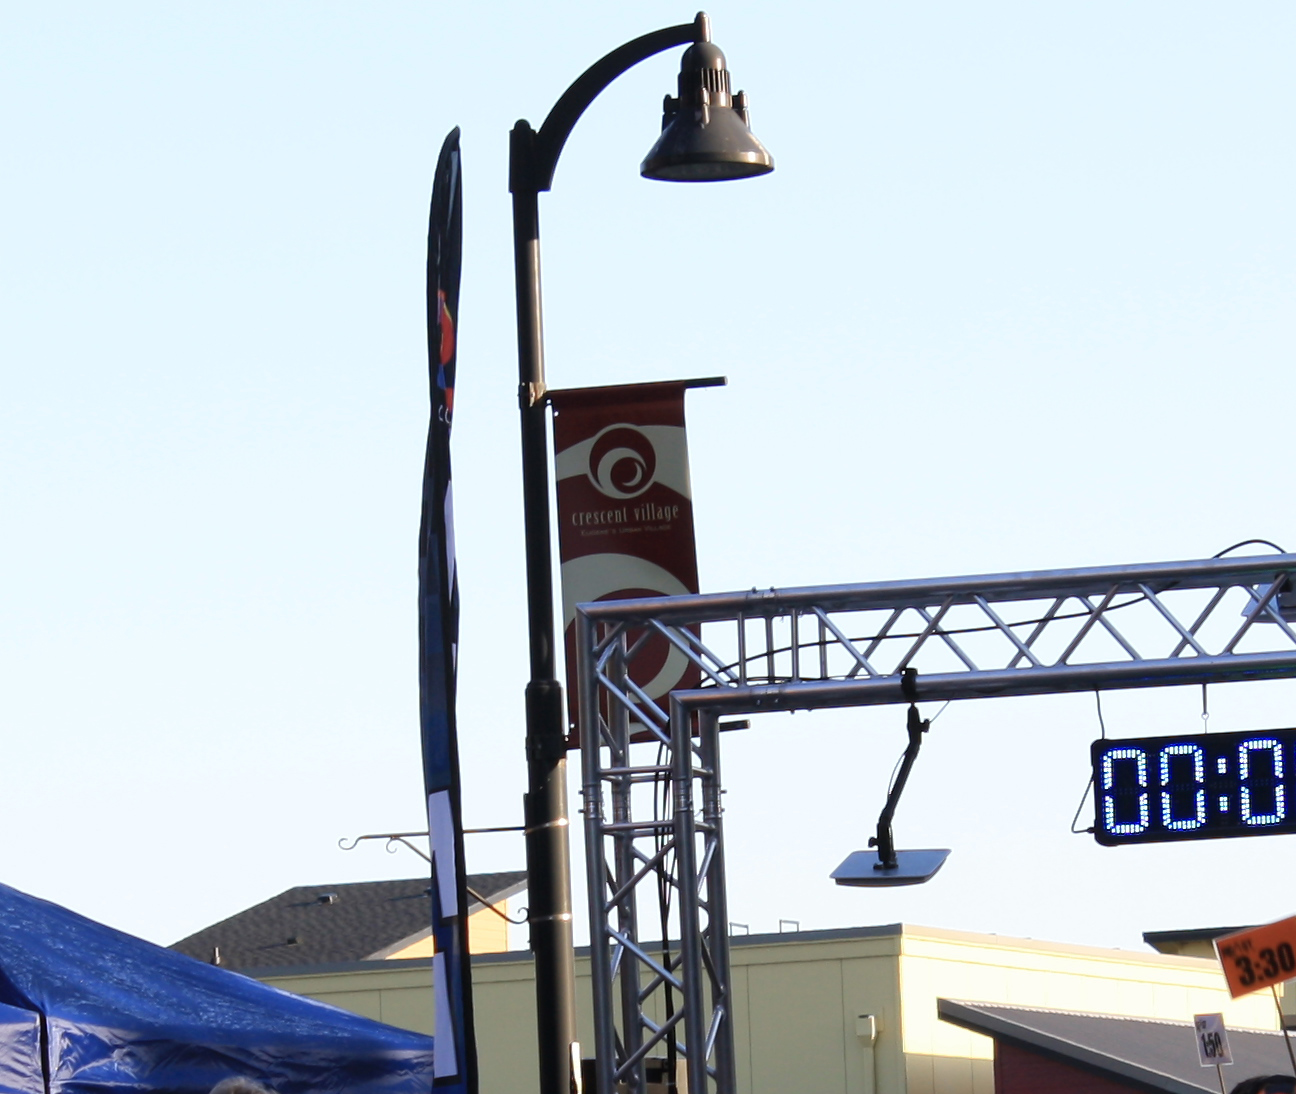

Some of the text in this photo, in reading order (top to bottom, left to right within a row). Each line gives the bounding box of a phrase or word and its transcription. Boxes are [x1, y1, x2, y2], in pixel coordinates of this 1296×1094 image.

[571, 502, 679, 526] crescent village
[1234, 941, 1296, 988] 3:30
